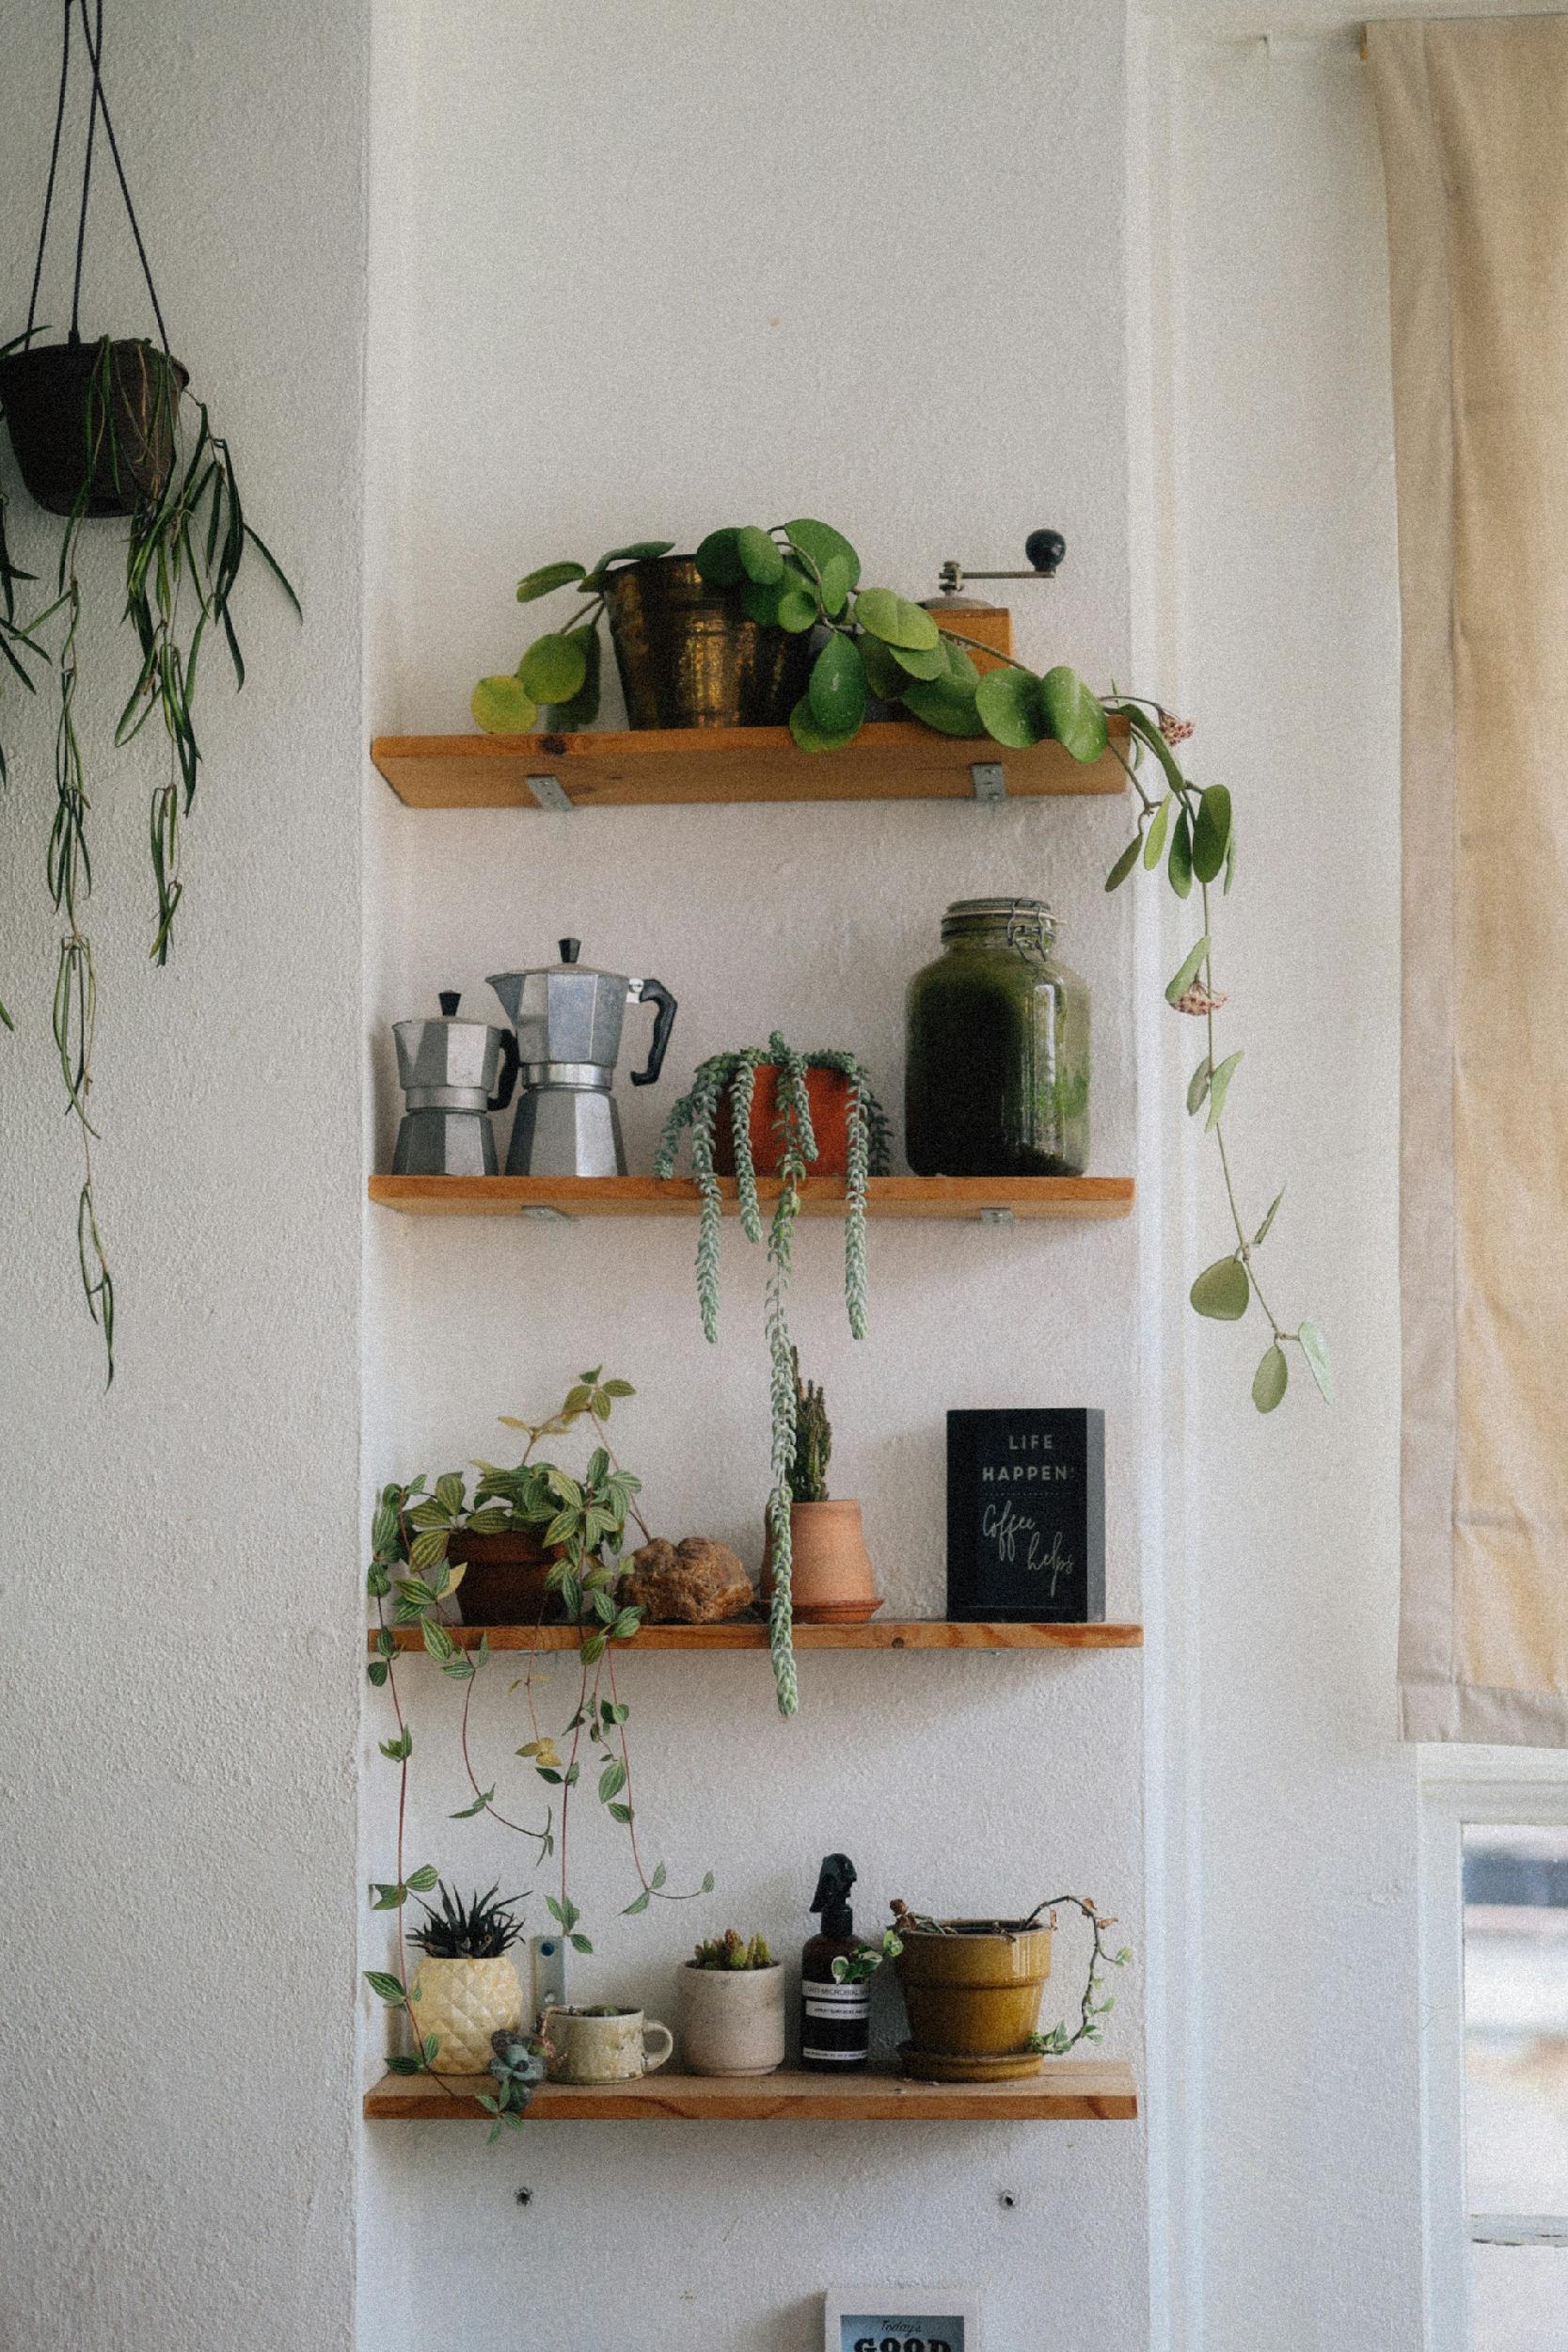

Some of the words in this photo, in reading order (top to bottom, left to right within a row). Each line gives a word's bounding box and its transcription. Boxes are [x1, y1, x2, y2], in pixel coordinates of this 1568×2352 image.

[1008, 1434, 1053, 1450] LIFE
[982, 1465, 1076, 1482] HAPPEN
[982, 1500, 1036, 1563] Coffee
[1027, 1531, 1074, 1598] helps
